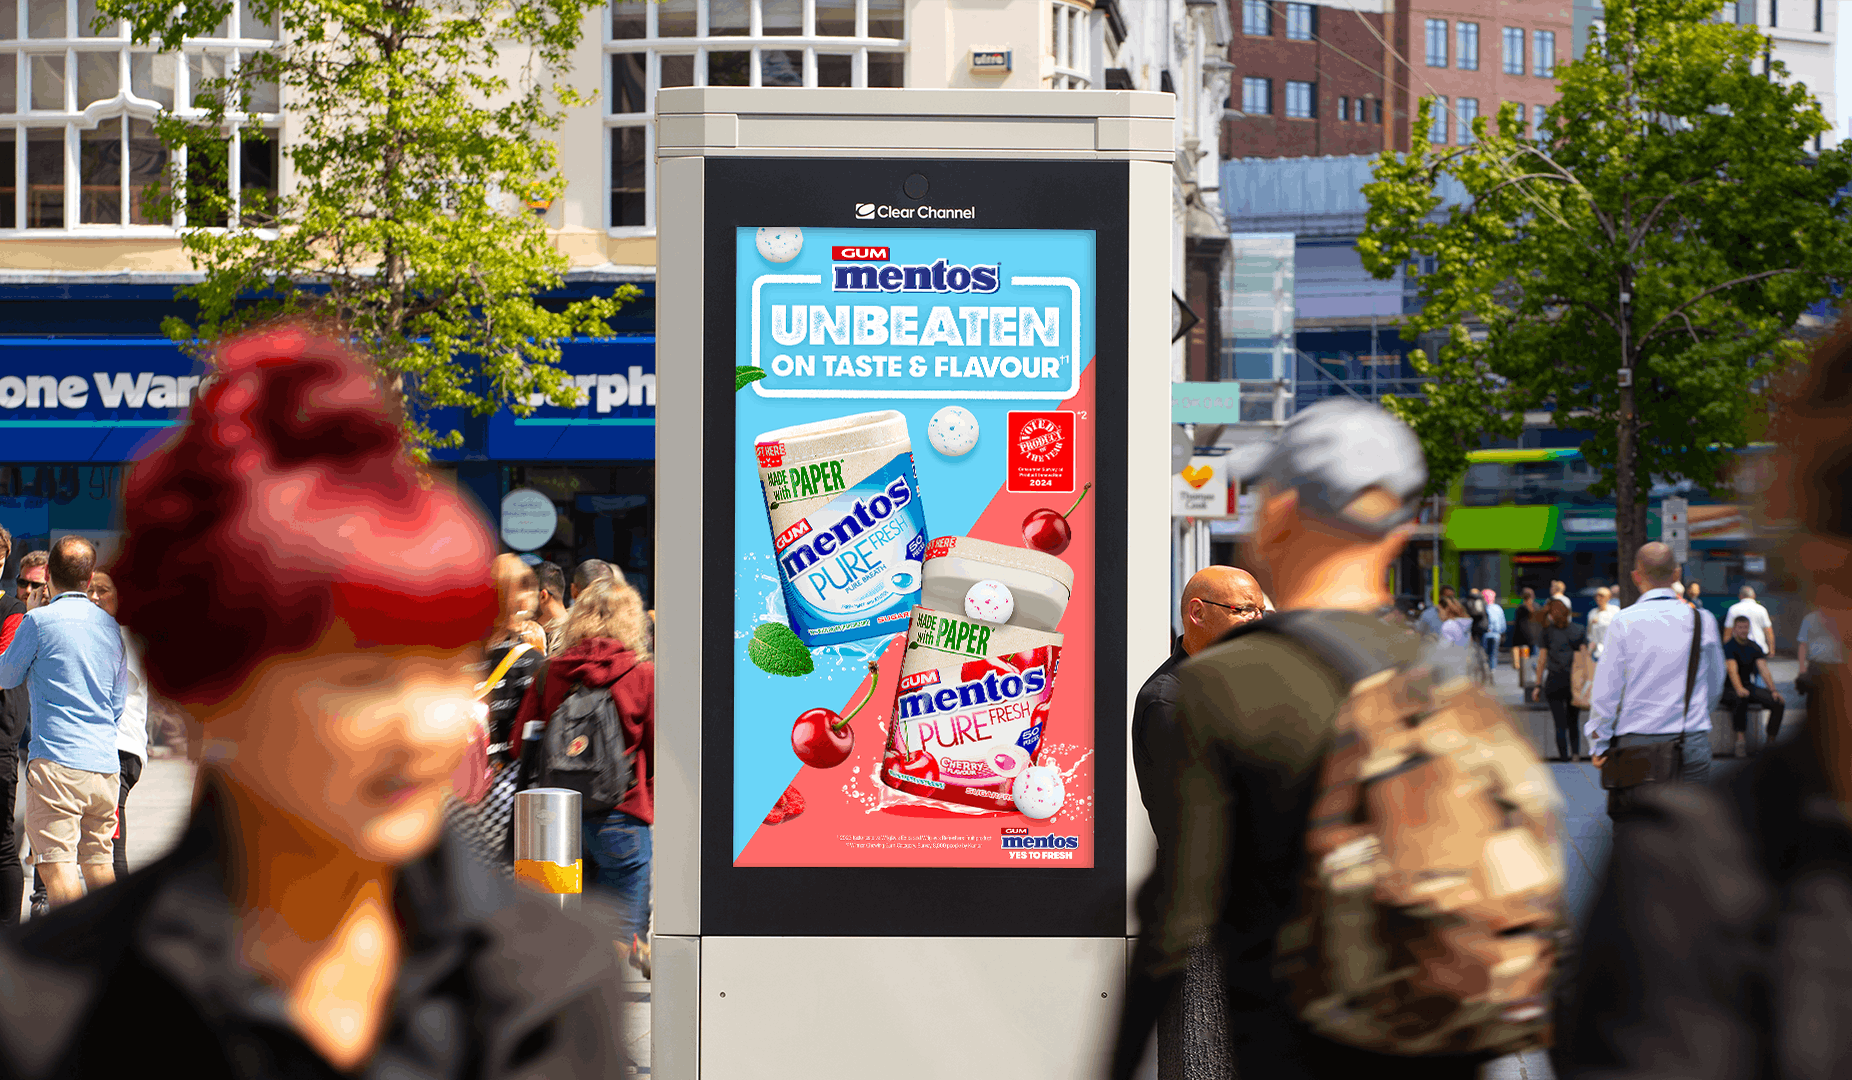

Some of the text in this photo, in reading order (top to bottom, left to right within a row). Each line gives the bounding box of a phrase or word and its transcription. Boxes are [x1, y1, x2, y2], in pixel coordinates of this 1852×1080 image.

[877, 205, 975, 219] Clear Channel
[841, 248, 886, 259] GUM
[832, 258, 1000, 294] mentos
[771, 304, 1060, 347] UNBEATEN
[771, 354, 815, 377] ON
[822, 355, 902, 377] TASTE
[908, 355, 928, 378] &
[1021, 419, 1055, 441] VOTED
[1019, 431, 1063, 453] PRODUCT
[1026, 442, 1063, 462] THE YEAR
[767, 460, 845, 498] MADE PAPER
[1029, 479, 1052, 487] 2024
[773, 485, 792, 501] with
[776, 521, 810, 549] GUM
[781, 475, 911, 581] mentos
[908, 535, 923, 552] 50
[808, 538, 882, 601] PURE
[868, 514, 908, 550] FRESH
[844, 580, 863, 594] PURE
[862, 564, 888, 583] BREATH
[916, 612, 991, 656] MADE PAPER
[916, 630, 934, 646] with
[900, 670, 938, 689] GUM
[899, 665, 1046, 720] mentos
[918, 701, 1031, 751] PURE FRESH
[1022, 726, 1040, 740] 50
[941, 757, 984, 771] CHERRY
[1001, 833, 1079, 850] mentos
[1008, 851, 1073, 860] YES TO FRESH
